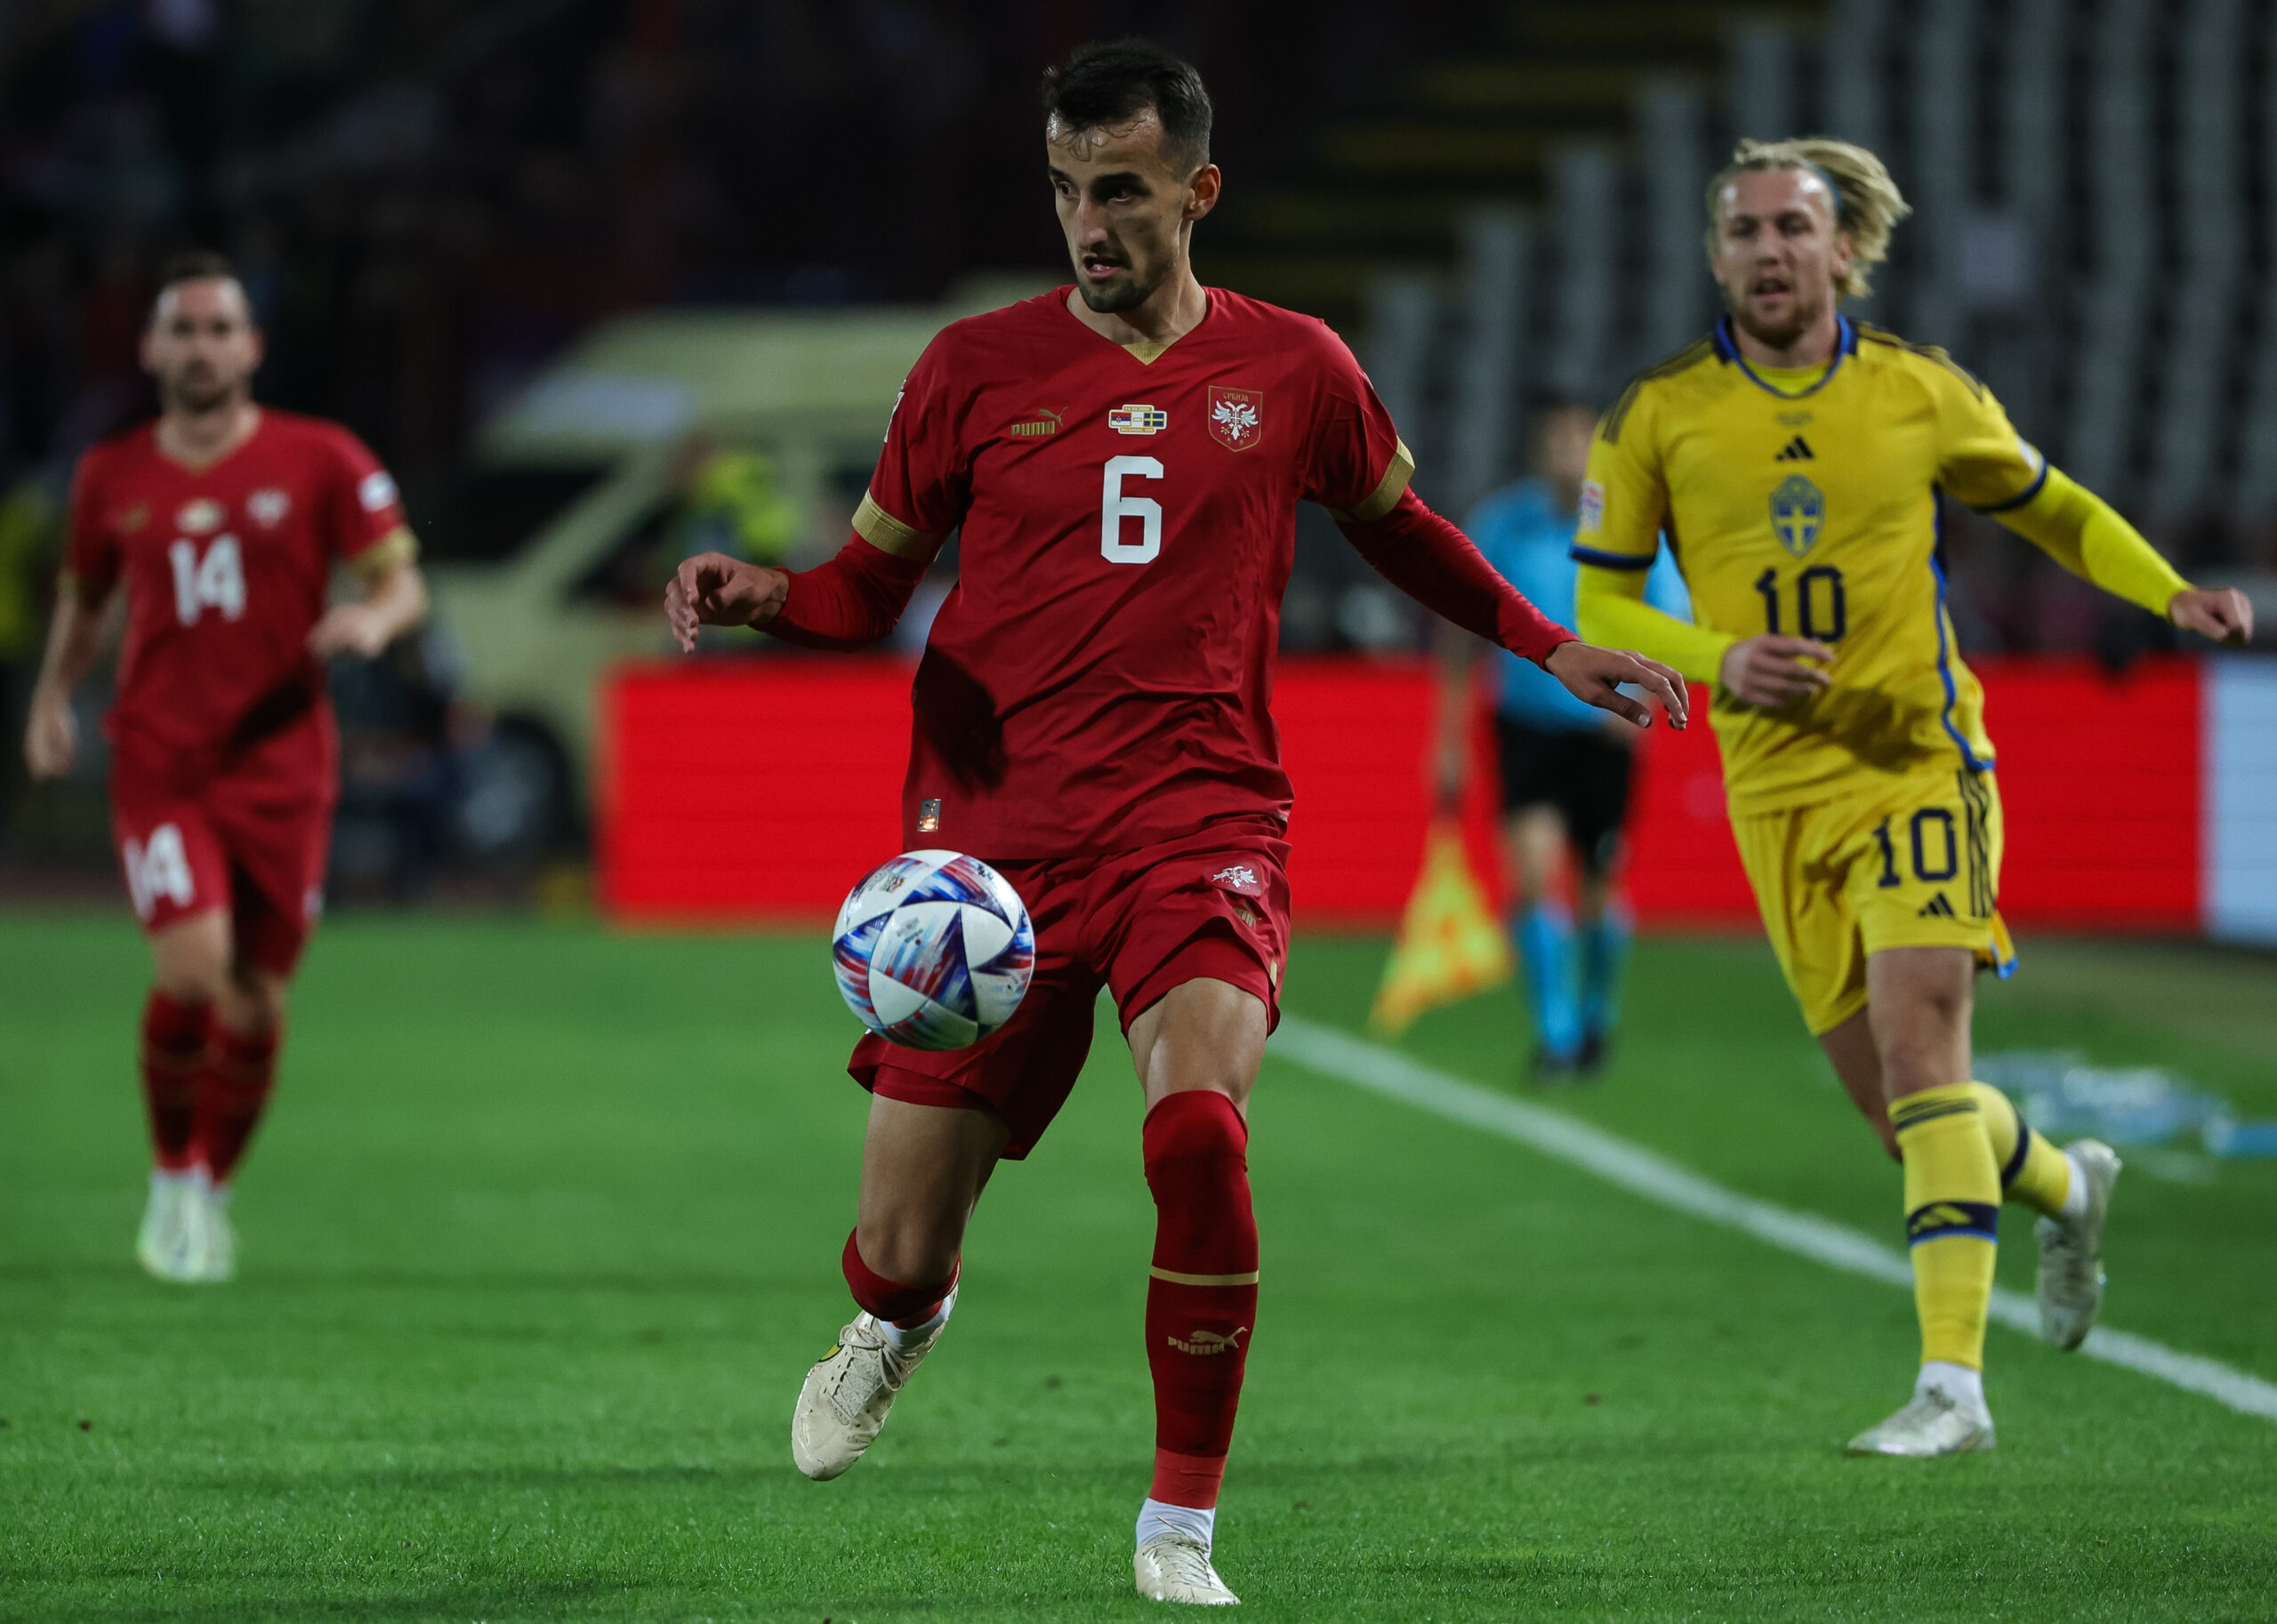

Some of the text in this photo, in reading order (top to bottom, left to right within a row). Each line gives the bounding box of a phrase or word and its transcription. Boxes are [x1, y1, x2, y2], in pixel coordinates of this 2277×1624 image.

[1010, 421, 1056, 437] PUMA
[1101, 455, 1163, 563] 6
[169, 535, 246, 627] 14
[1754, 566, 1845, 642] 10
[123, 823, 195, 921] 14
[1872, 807, 1958, 888] 10
[1168, 1336, 1224, 1355] PUMA
